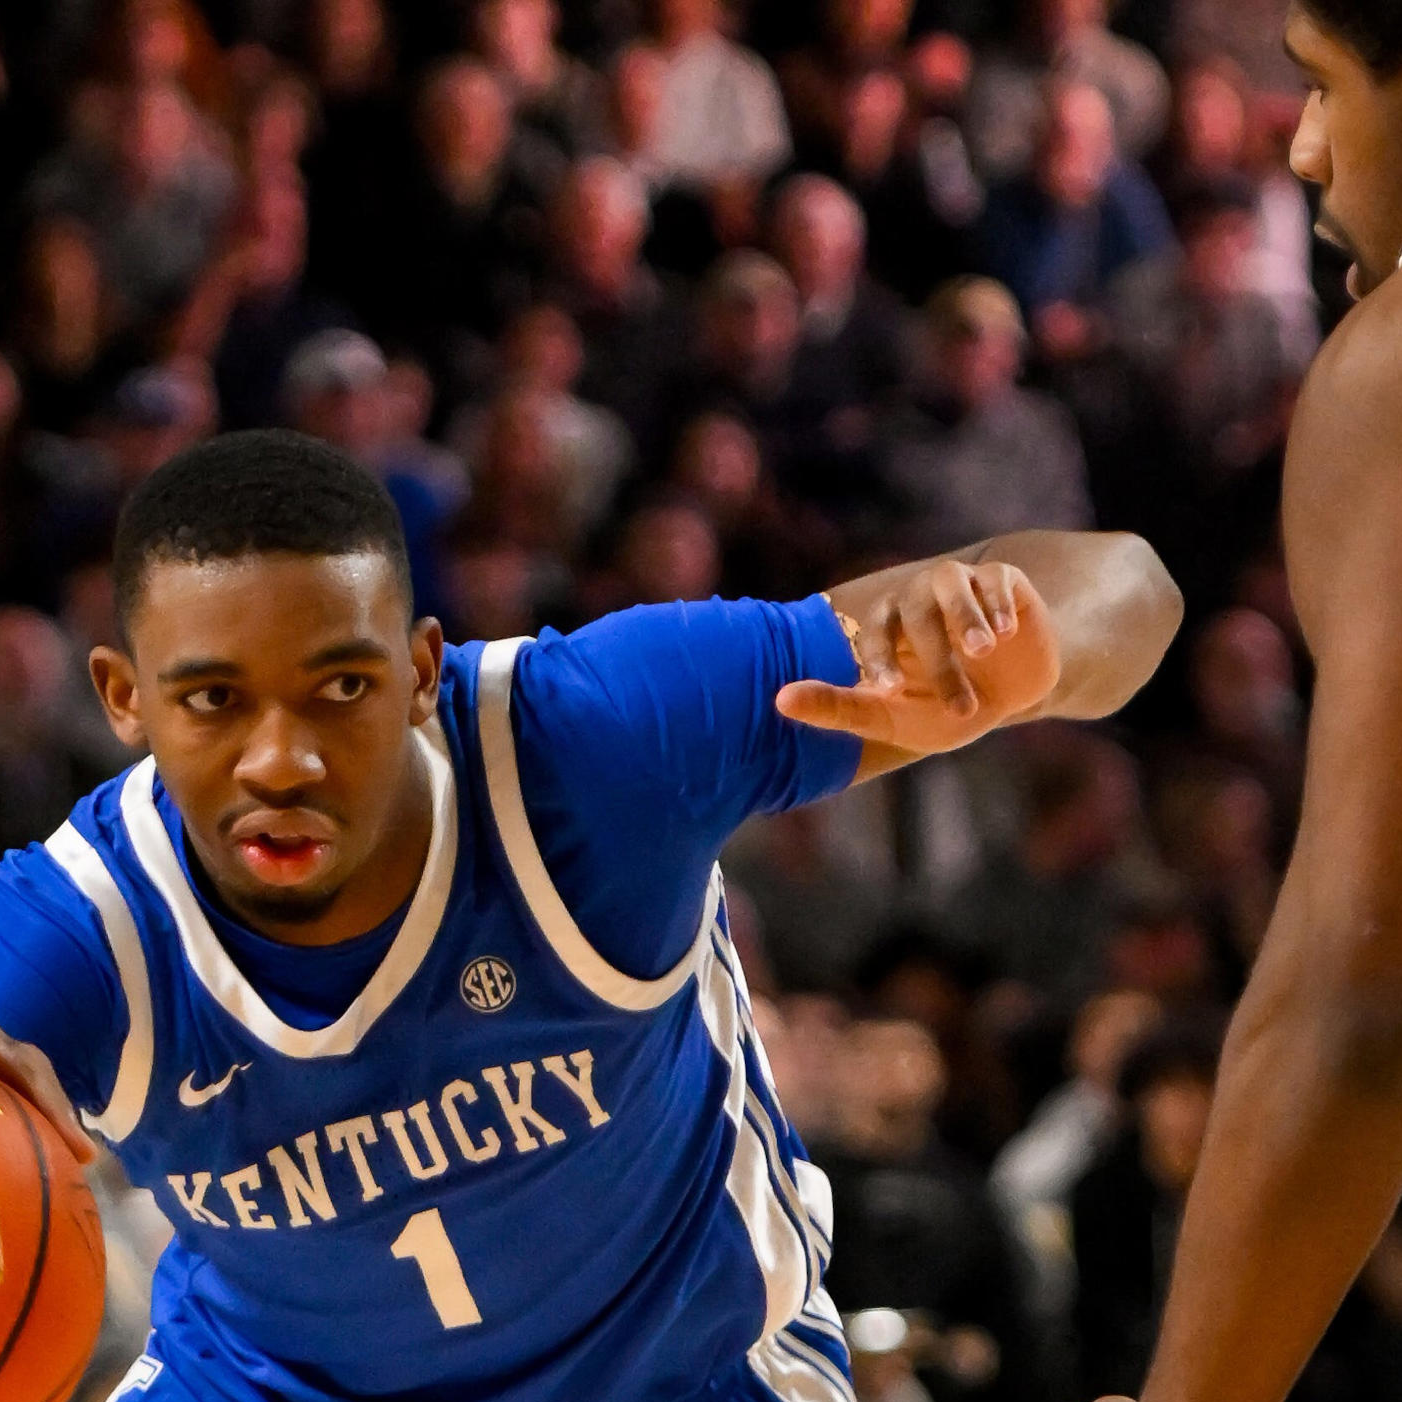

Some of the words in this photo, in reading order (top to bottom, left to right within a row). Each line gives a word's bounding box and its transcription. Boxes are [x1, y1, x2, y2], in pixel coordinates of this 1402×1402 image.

[464, 961, 511, 1008] SEC
[167, 1049, 611, 1229] KENTUCKY
[390, 1207, 482, 1329] 1
